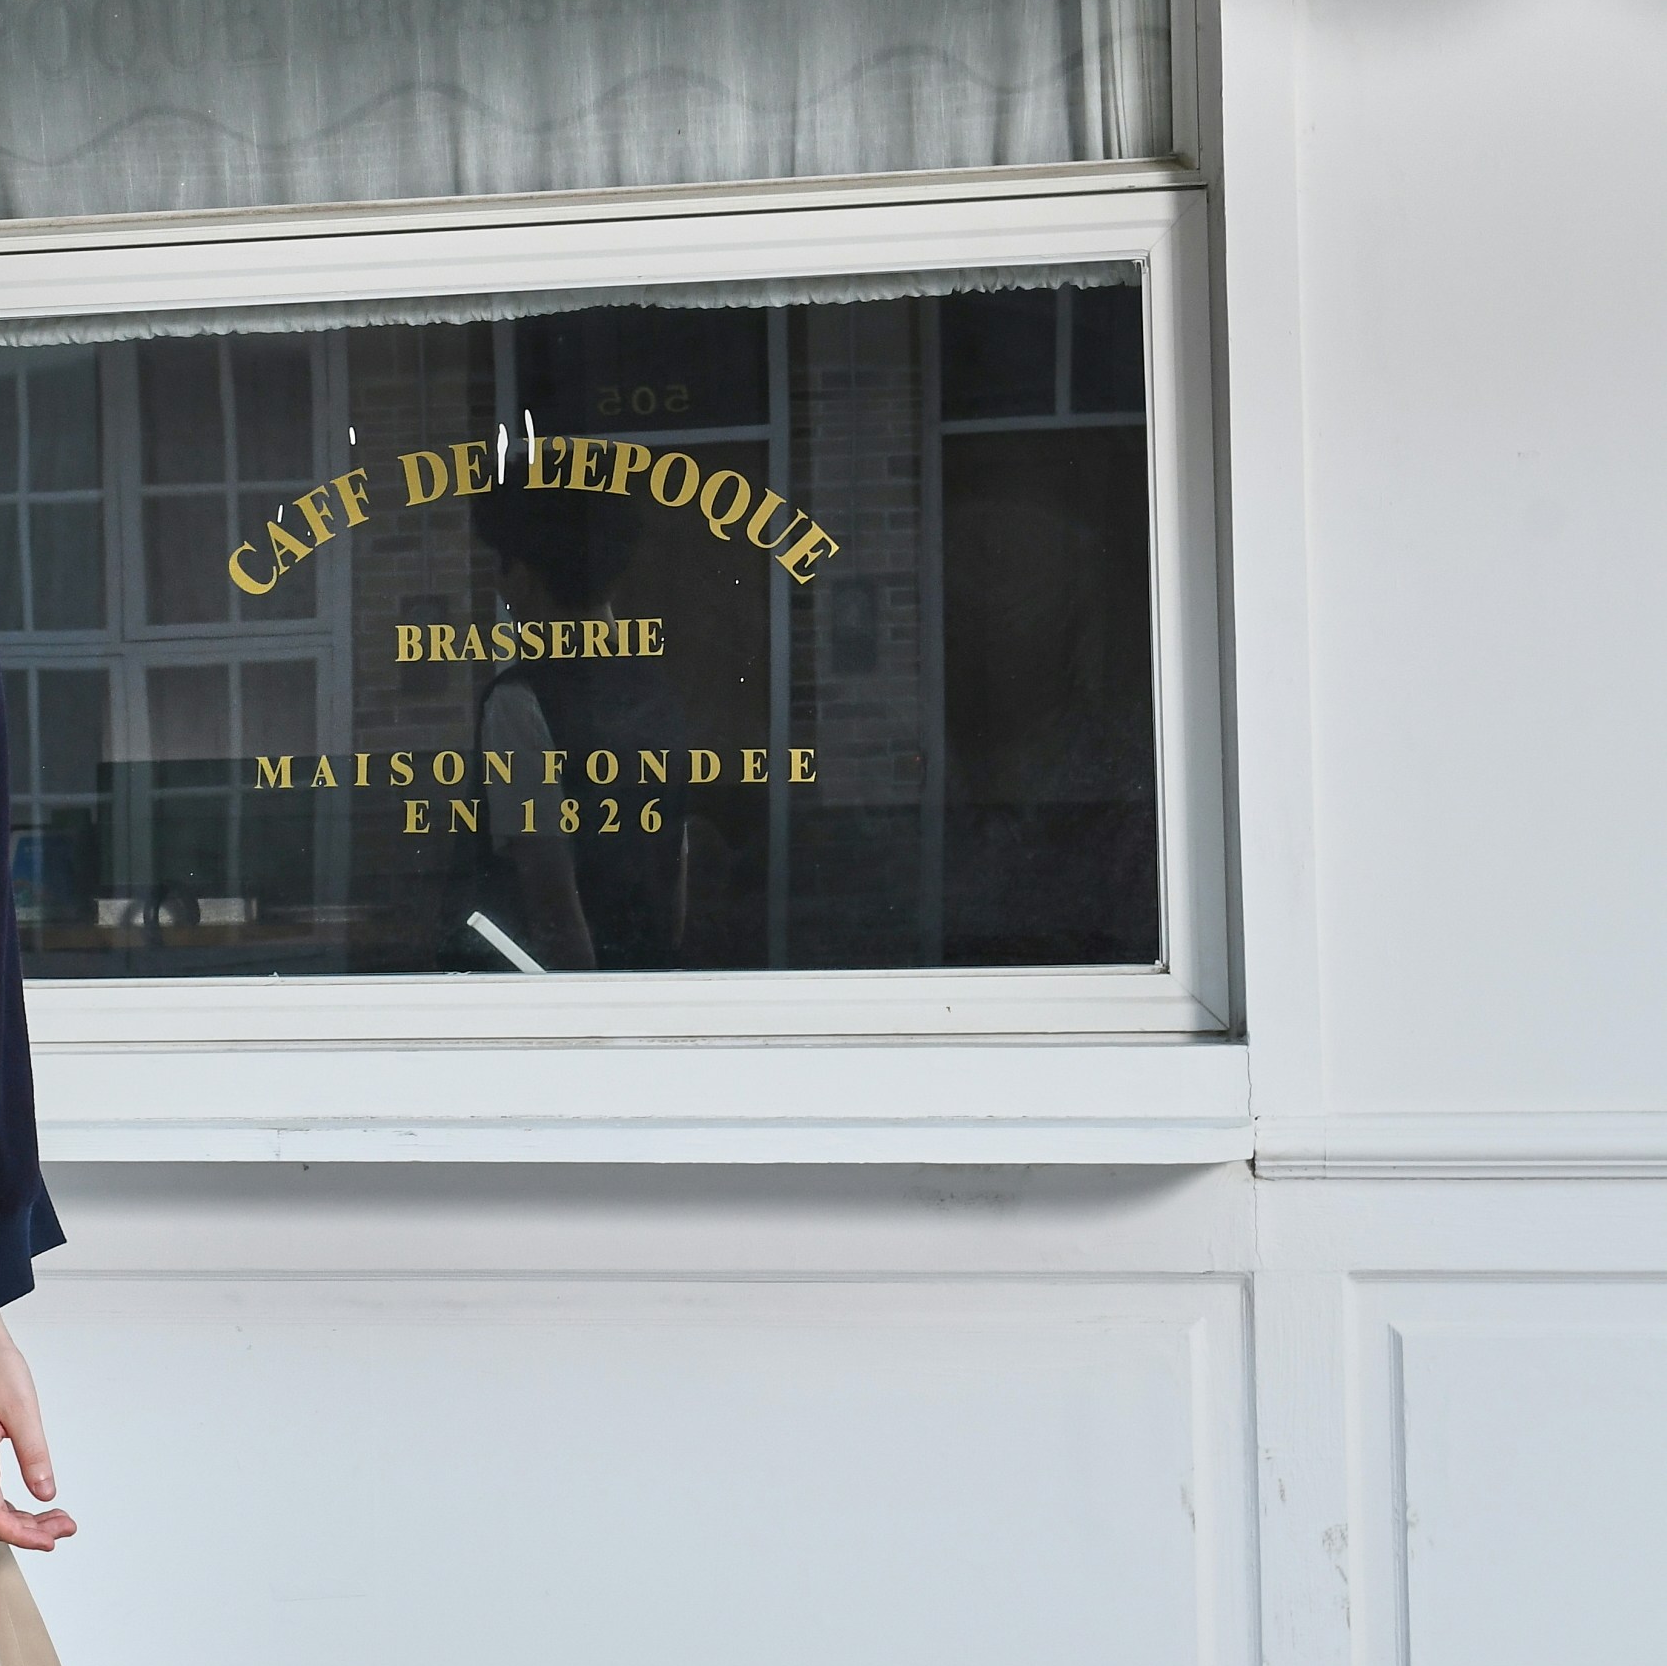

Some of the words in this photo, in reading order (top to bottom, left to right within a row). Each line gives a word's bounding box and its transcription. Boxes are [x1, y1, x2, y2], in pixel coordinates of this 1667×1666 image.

[228, 468, 369, 596] CAFF
[398, 440, 493, 507] DE
[523, 436, 840, 585] L'EPOQUE
[395, 618, 665, 662] BRASSERIE
[255, 750, 514, 789] MAISON
[541, 748, 817, 784] FONDEE
[403, 799, 480, 834] EN
[521, 798, 663, 834] 1826
